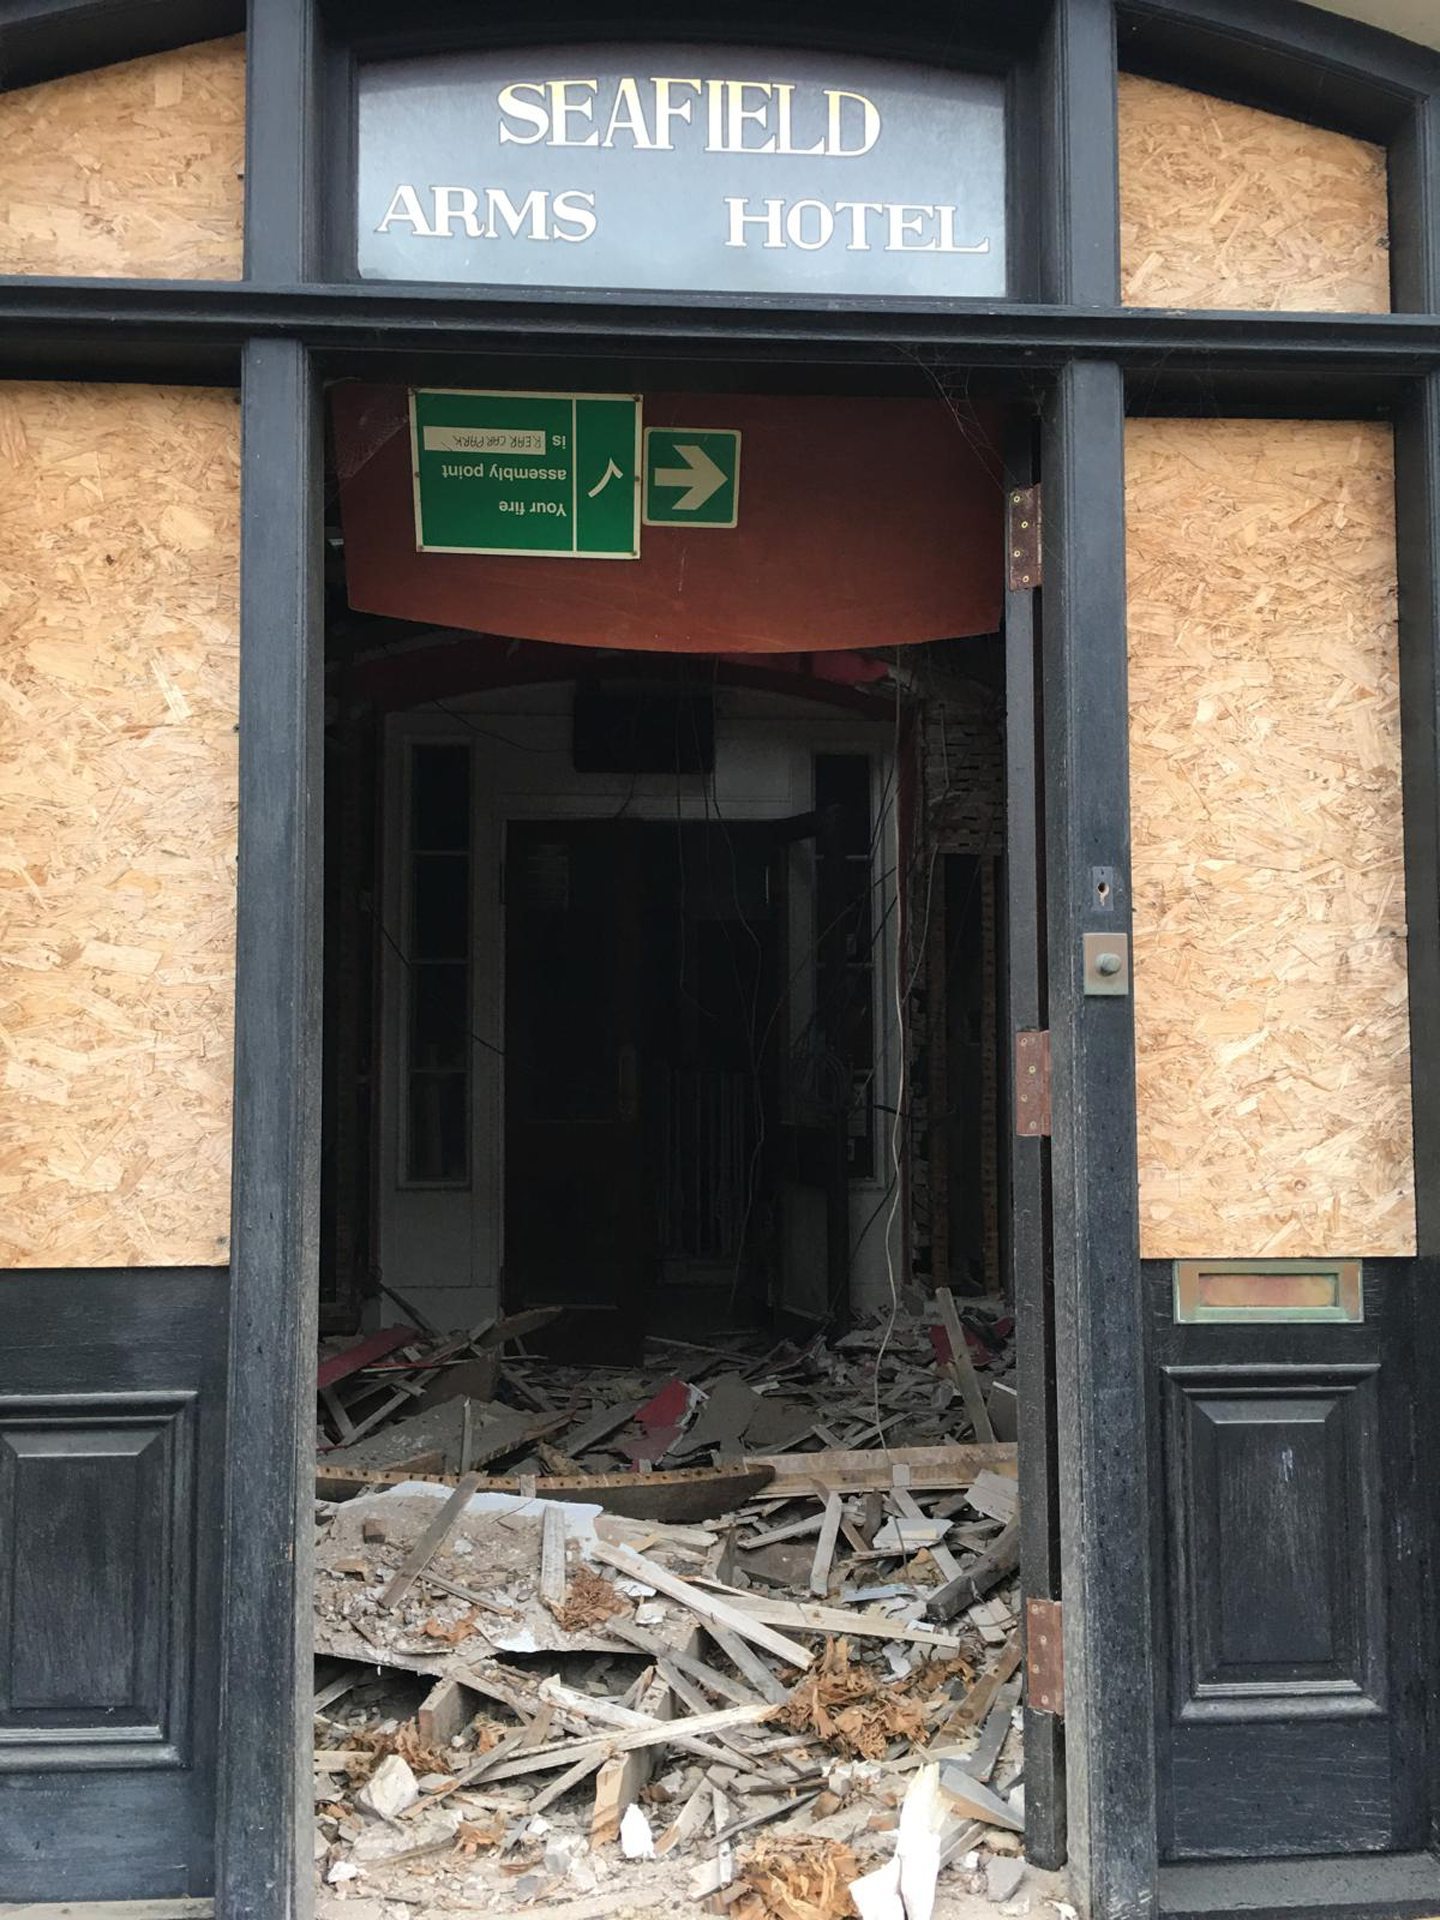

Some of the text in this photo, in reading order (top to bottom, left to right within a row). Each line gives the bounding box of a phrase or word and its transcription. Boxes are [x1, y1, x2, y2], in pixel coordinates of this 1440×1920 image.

[499, 77, 881, 157] SEAFIELD
[376, 184, 990, 253] ARMS HOTEL
[509, 435, 542, 448] REAR
[551, 434, 566, 449] is
[442, 463, 567, 481] assembly point
[499, 501, 567, 517] Your fire
